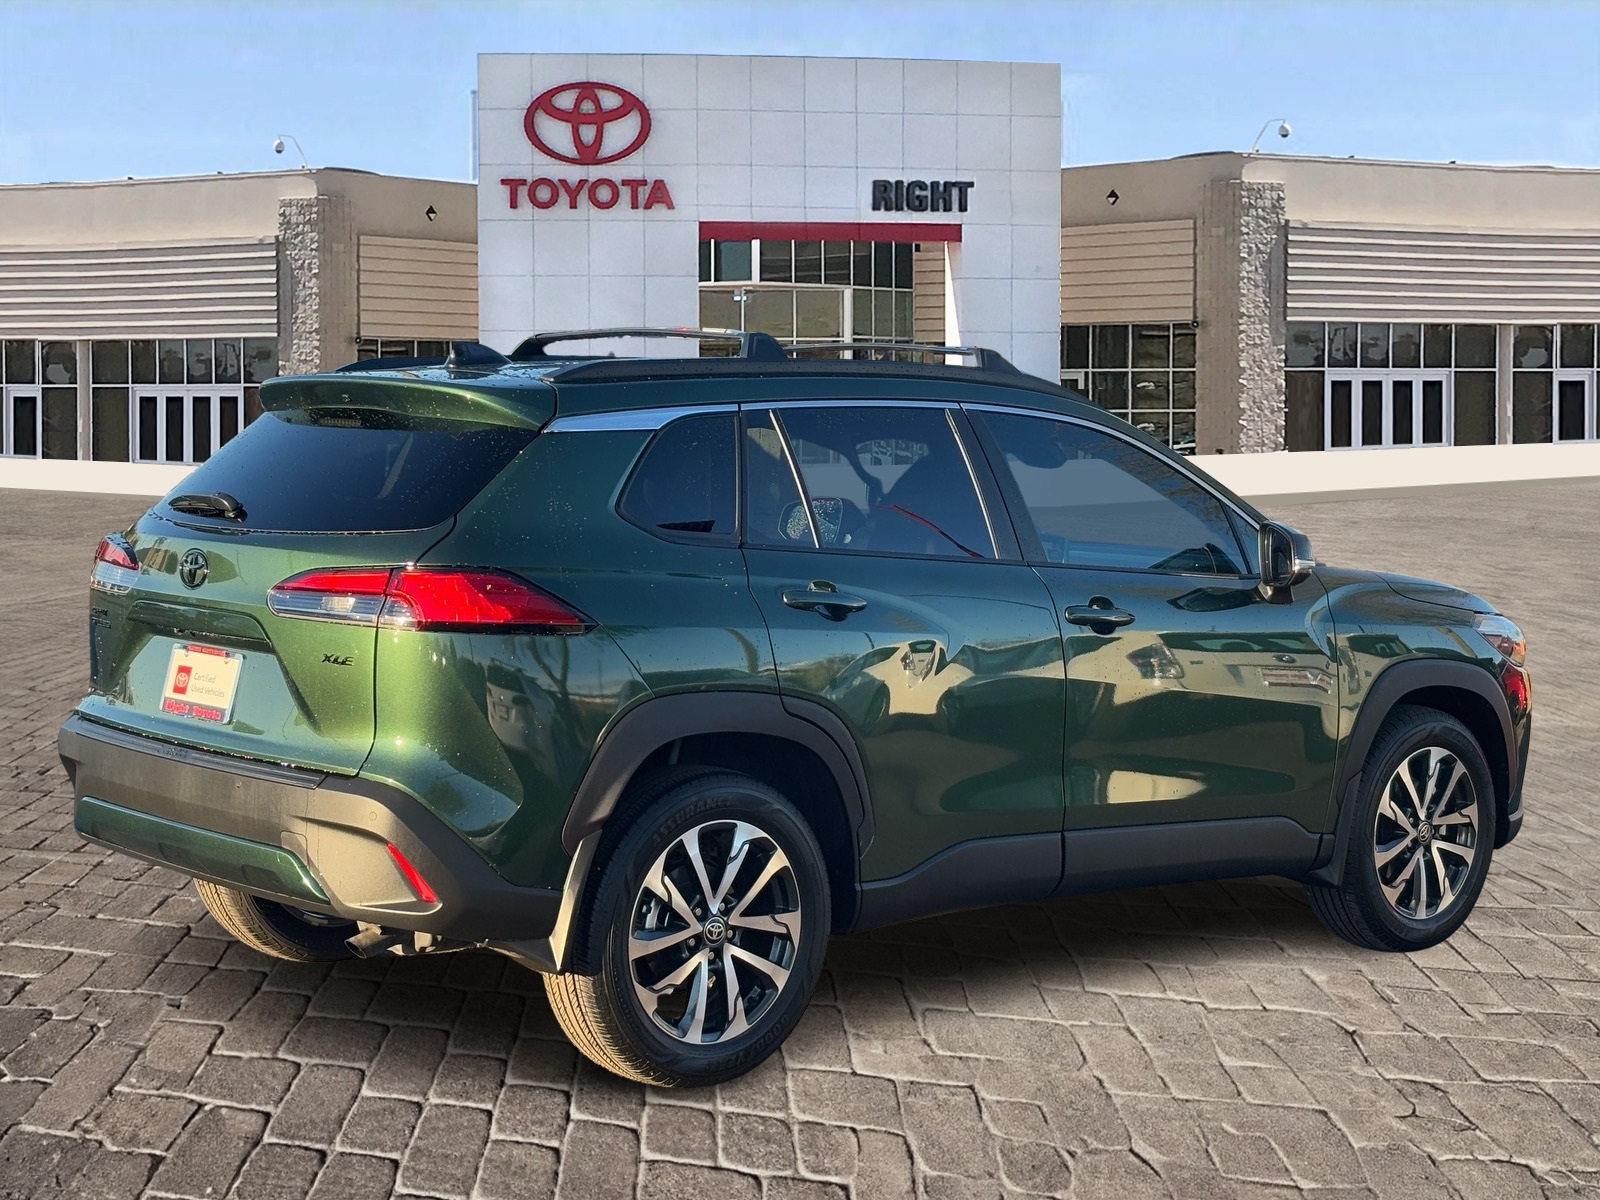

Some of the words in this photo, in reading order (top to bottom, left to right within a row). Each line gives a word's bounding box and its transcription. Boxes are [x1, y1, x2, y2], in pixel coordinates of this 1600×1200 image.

[501, 178, 675, 210] TOYOTA
[872, 180, 975, 213] RIGHT
[321, 653, 354, 666] XLE
[194, 672, 217, 684] Certified
[191, 685, 203, 694] Used
[205, 687, 225, 697] Vehicles
[165, 699, 190, 713] Right
[192, 705, 221, 720] Toyota
